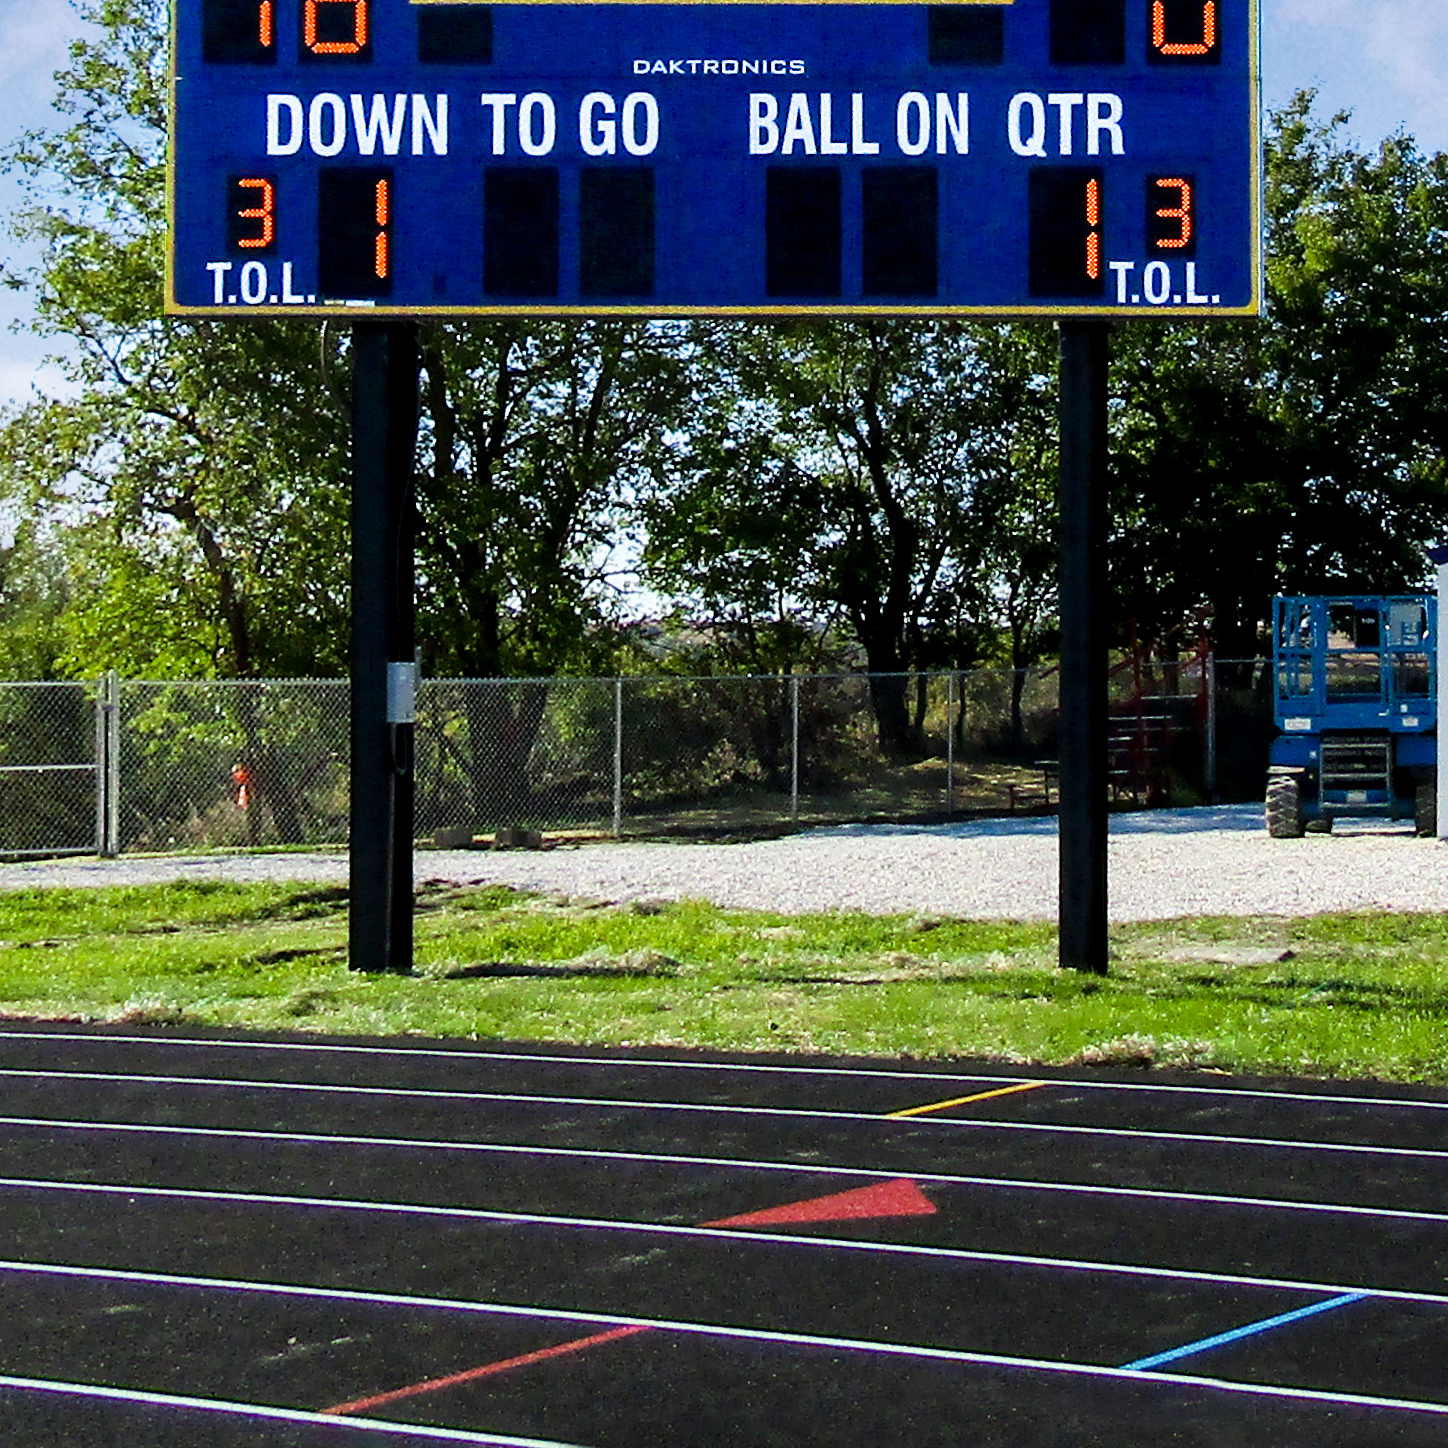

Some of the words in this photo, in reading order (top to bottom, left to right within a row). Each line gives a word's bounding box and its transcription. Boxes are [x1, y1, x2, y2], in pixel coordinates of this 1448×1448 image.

[633, 59, 805, 75] DAKTRONICS
[266, 93, 448, 156] DOWN
[481, 93, 556, 156] TO
[579, 92, 659, 156] GO
[749, 93, 880, 155] BALL
[896, 92, 969, 156] ON
[1007, 92, 1125, 158] QTR
[237, 178, 273, 248] 3
[375, 179, 388, 279] 1
[1086, 178, 1099, 279] 1
[1155, 178, 1191, 248] 3
[206, 262, 316, 304] T.O.L.
[1109, 262, 1220, 304] T.O.L.
